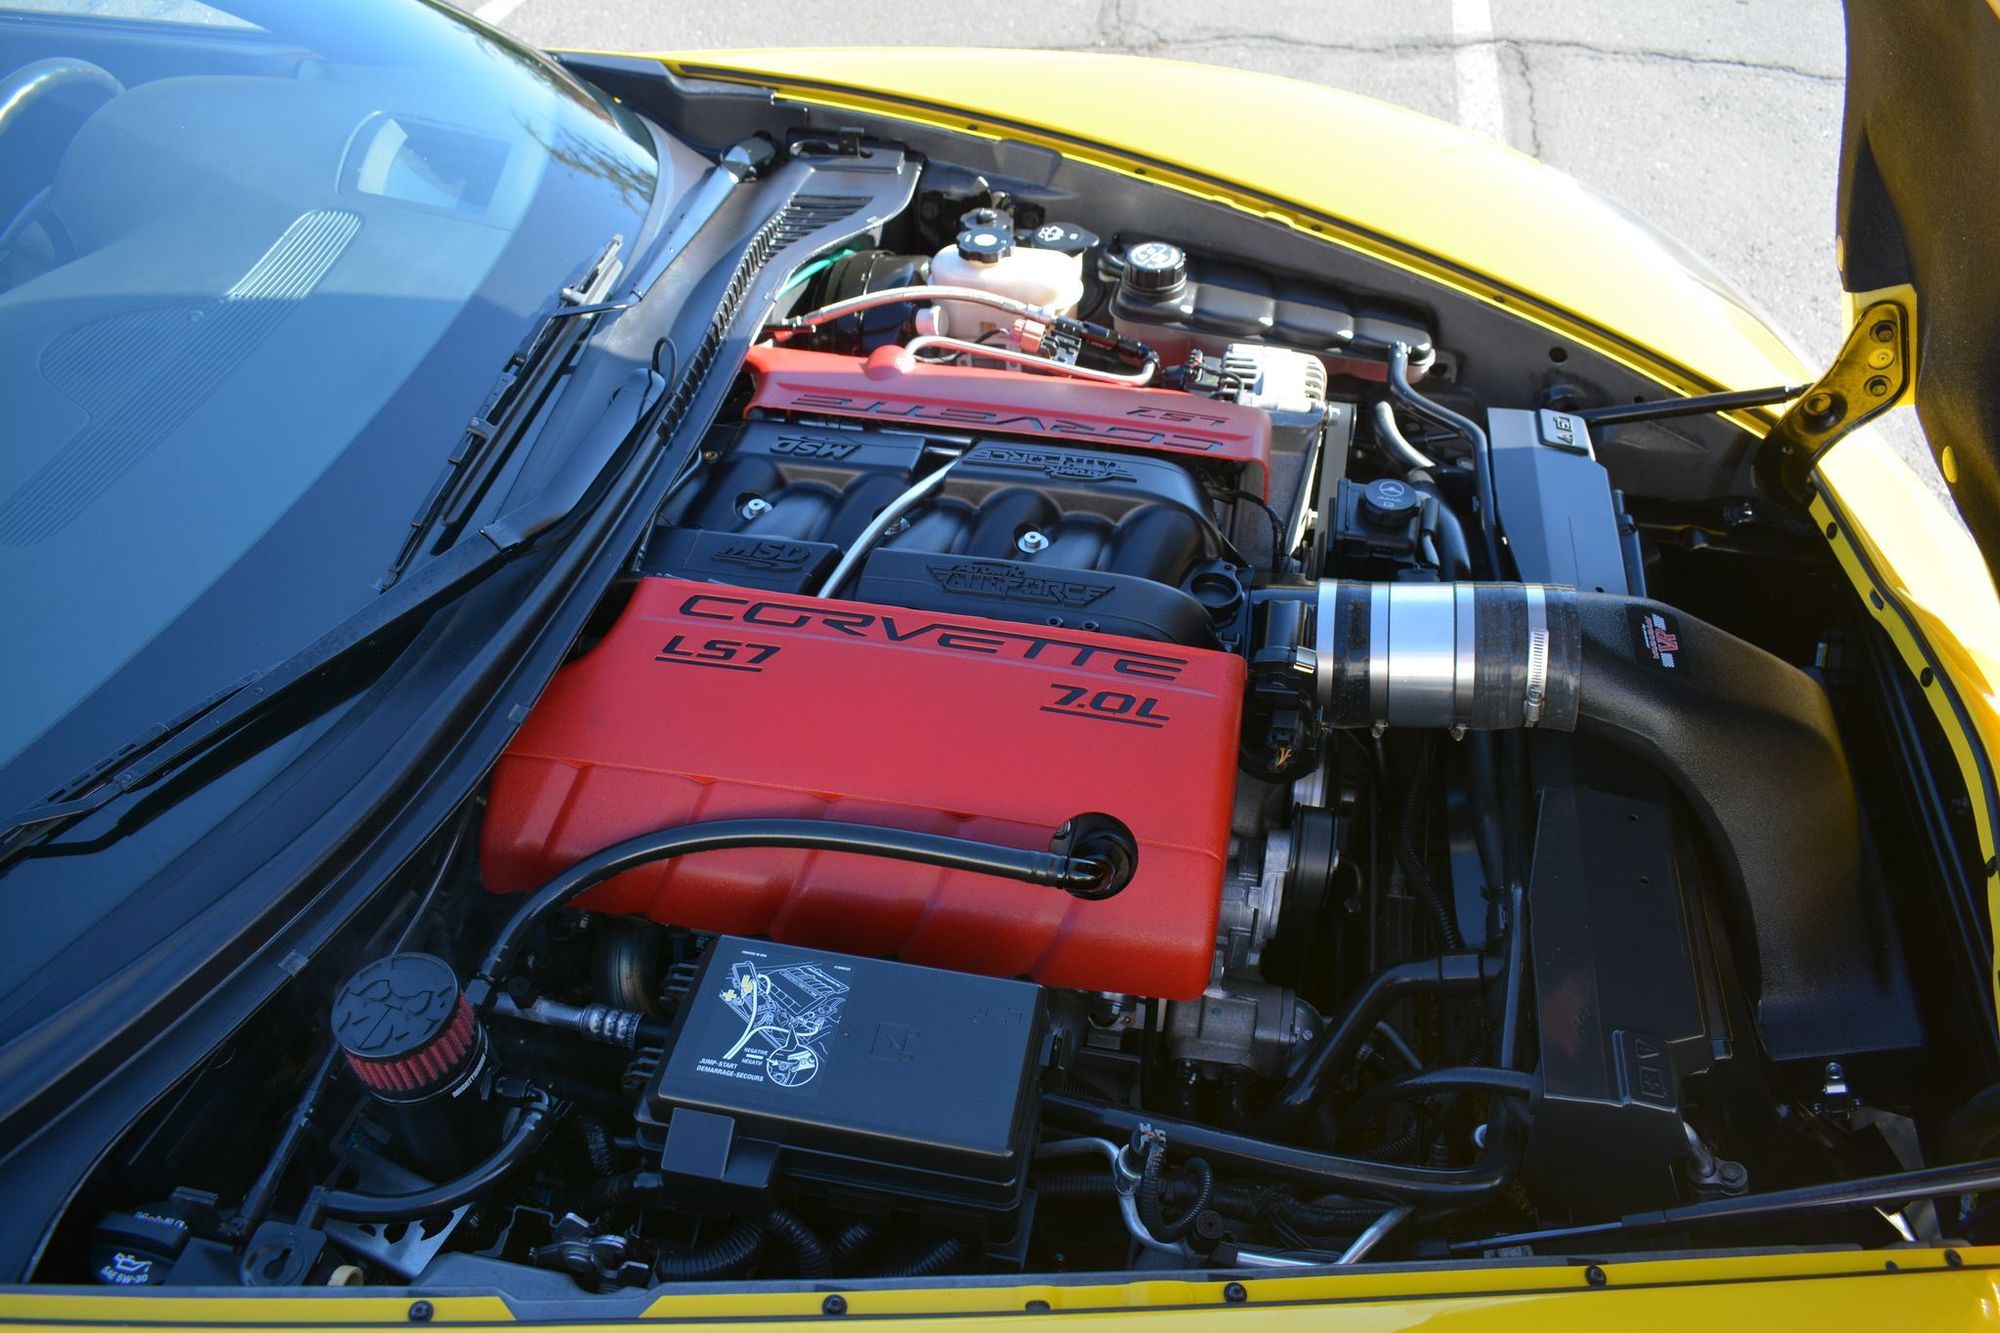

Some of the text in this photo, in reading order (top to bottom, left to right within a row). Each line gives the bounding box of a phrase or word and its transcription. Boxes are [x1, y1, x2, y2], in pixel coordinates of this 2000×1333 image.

[794, 395, 1223, 451] CORVETTE
[1126, 407, 1231, 427] LS7
[770, 437, 861, 460] MSD
[713, 540, 812, 565] MSD
[661, 635, 781, 664] LS7
[679, 594, 1188, 682] CORVETTE
[1050, 684, 1170, 722] 7.0L
[699, 1058, 738, 1070] JUMP-START
